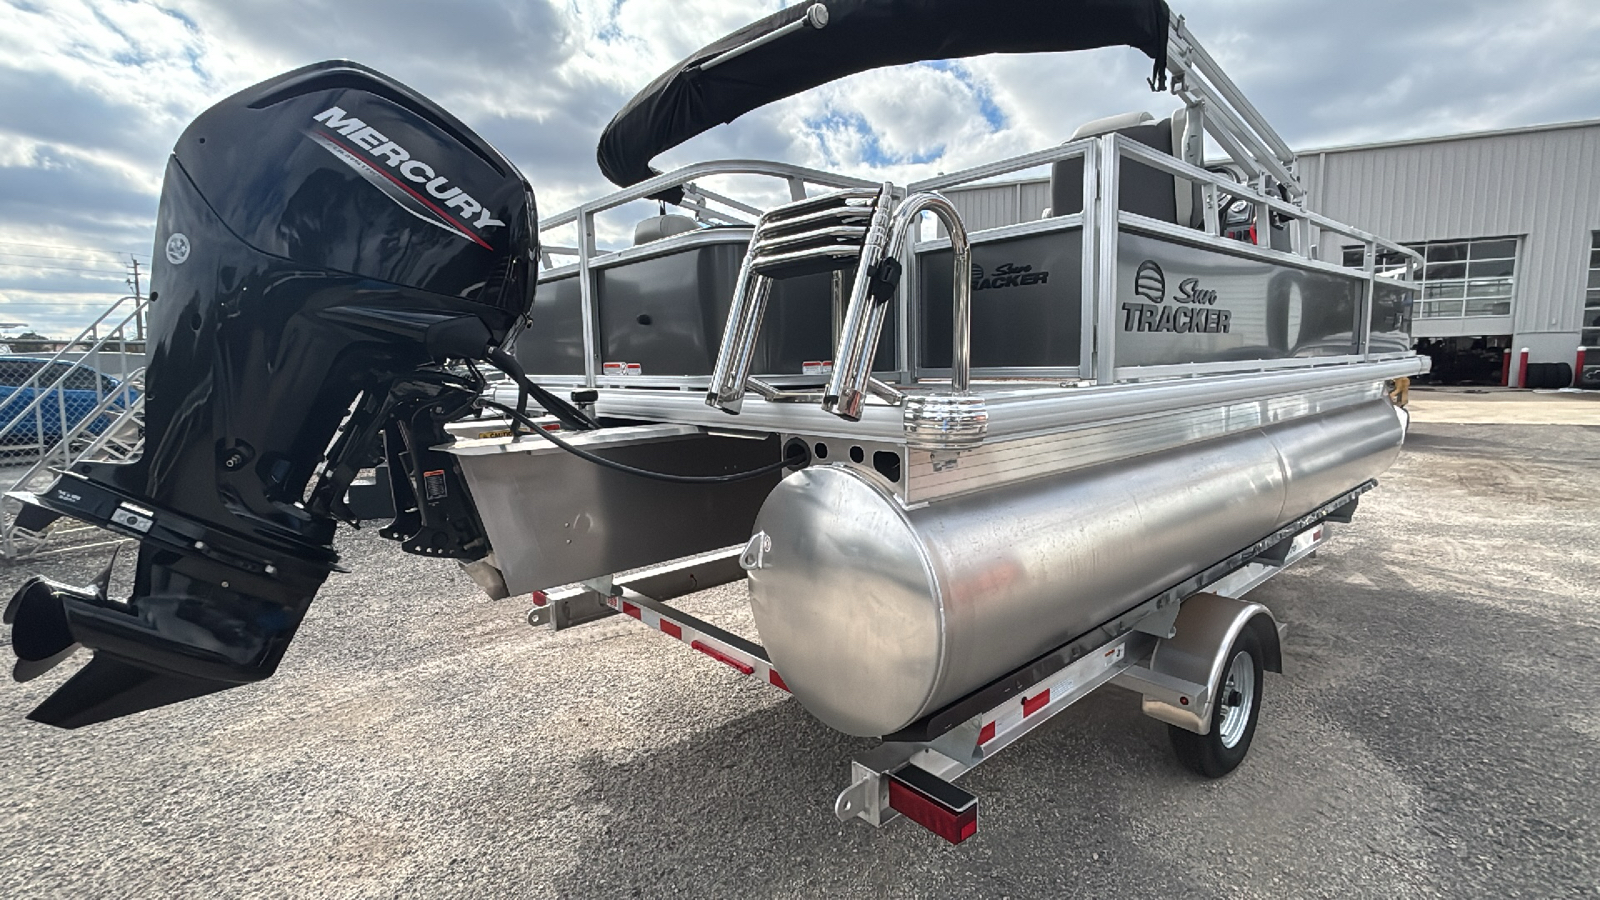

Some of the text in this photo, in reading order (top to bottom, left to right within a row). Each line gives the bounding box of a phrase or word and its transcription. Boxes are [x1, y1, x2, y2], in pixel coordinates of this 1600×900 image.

[313, 106, 505, 229] MERCURY
[971, 271, 1049, 290] RACKER
[992, 263, 1032, 276] Sun
[1173, 278, 1218, 305] Sun
[1122, 302, 1232, 333] TRACKER
